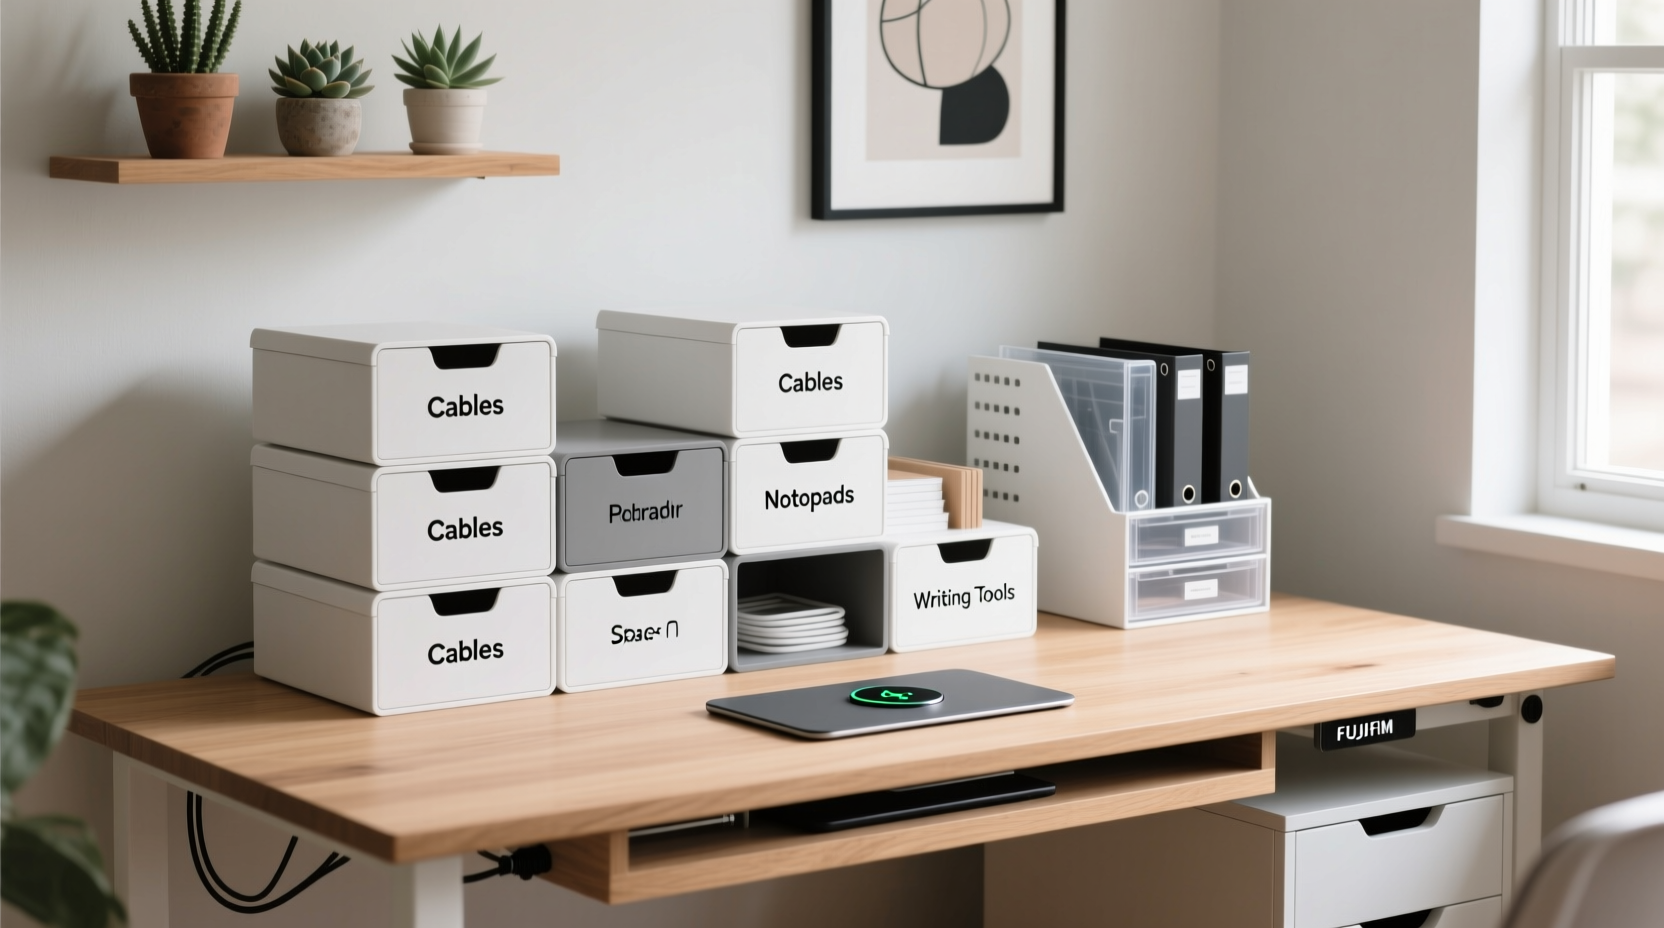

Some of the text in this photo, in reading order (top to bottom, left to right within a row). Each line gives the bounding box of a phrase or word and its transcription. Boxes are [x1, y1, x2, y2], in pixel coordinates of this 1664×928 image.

[779, 371, 844, 394] Cables
[427, 393, 504, 419] Cables
[764, 484, 855, 512] Notopads
[427, 516, 504, 542] Cables
[913, 582, 1016, 610] Writing Tools
[427, 638, 504, 665] Cables
